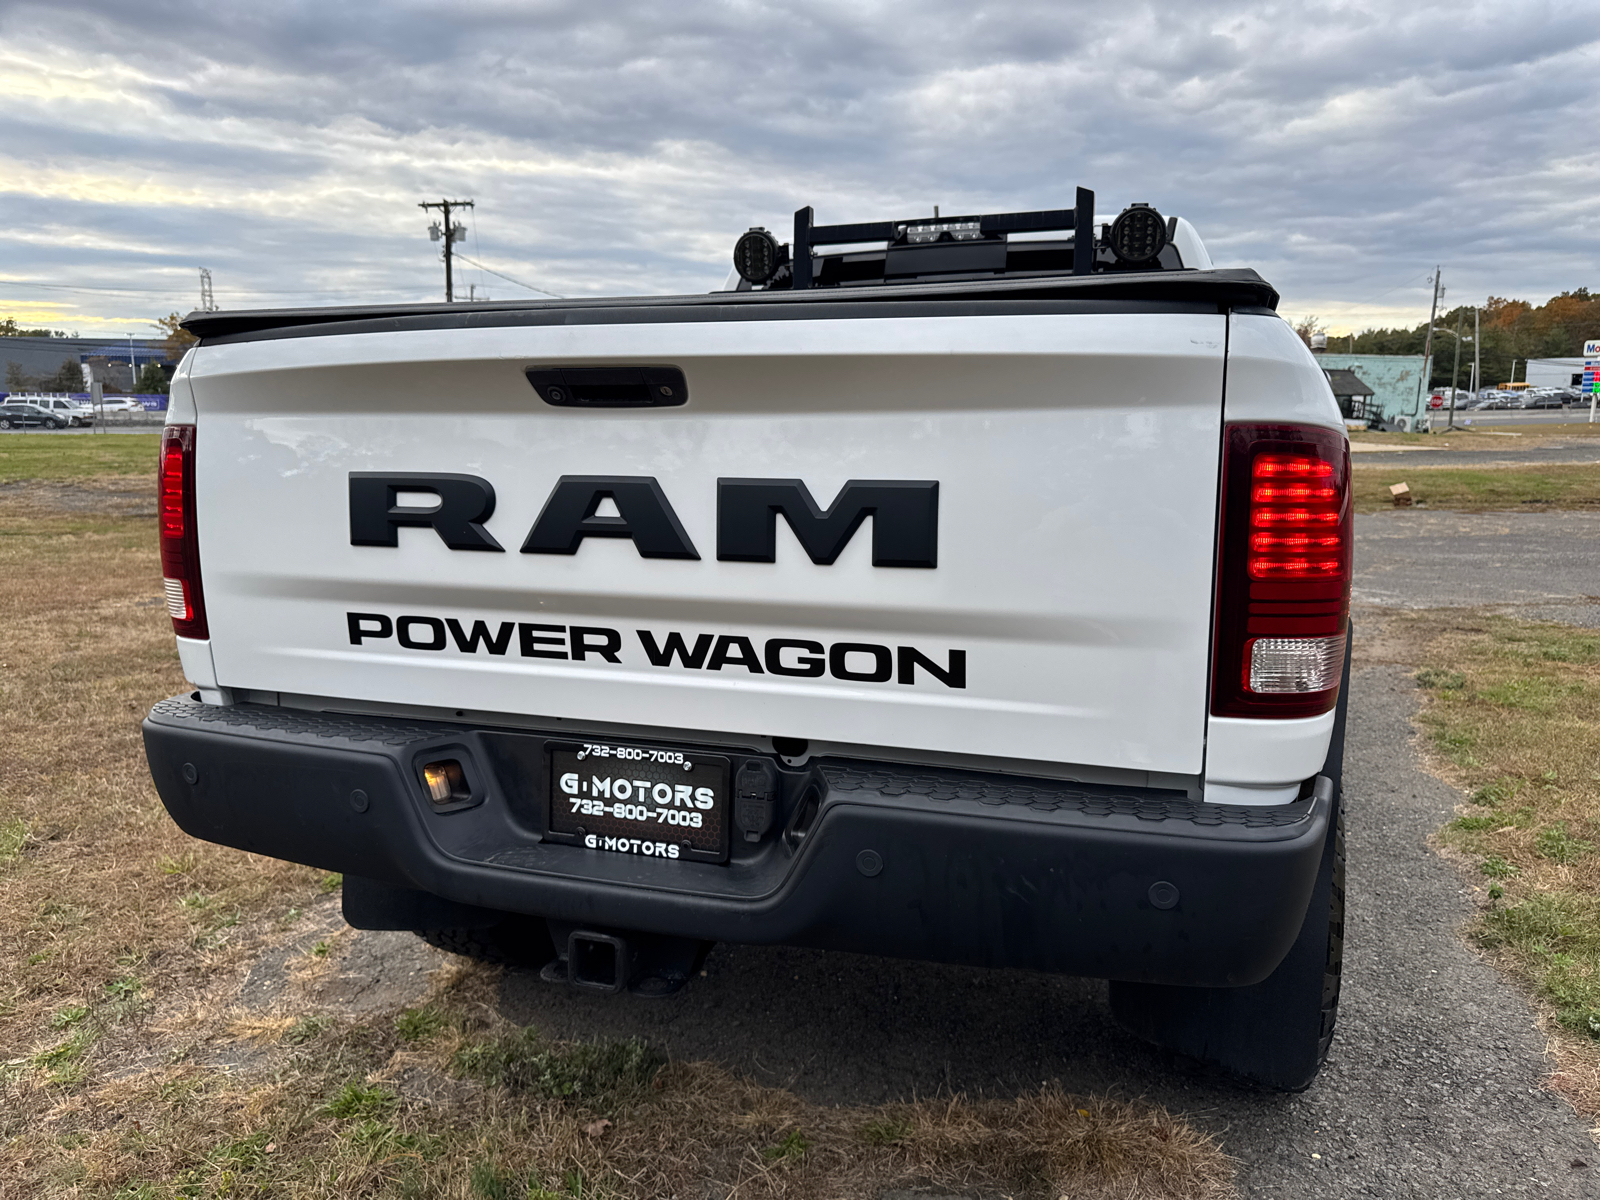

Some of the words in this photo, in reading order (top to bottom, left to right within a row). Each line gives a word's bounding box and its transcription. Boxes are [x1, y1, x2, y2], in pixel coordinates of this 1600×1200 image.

[349, 471, 939, 569] RAM
[346, 612, 622, 664] POWER
[636, 630, 966, 689] WAGON
[583, 744, 684, 764] 732-800-7003
[569, 797, 703, 828] 732-800-7003
